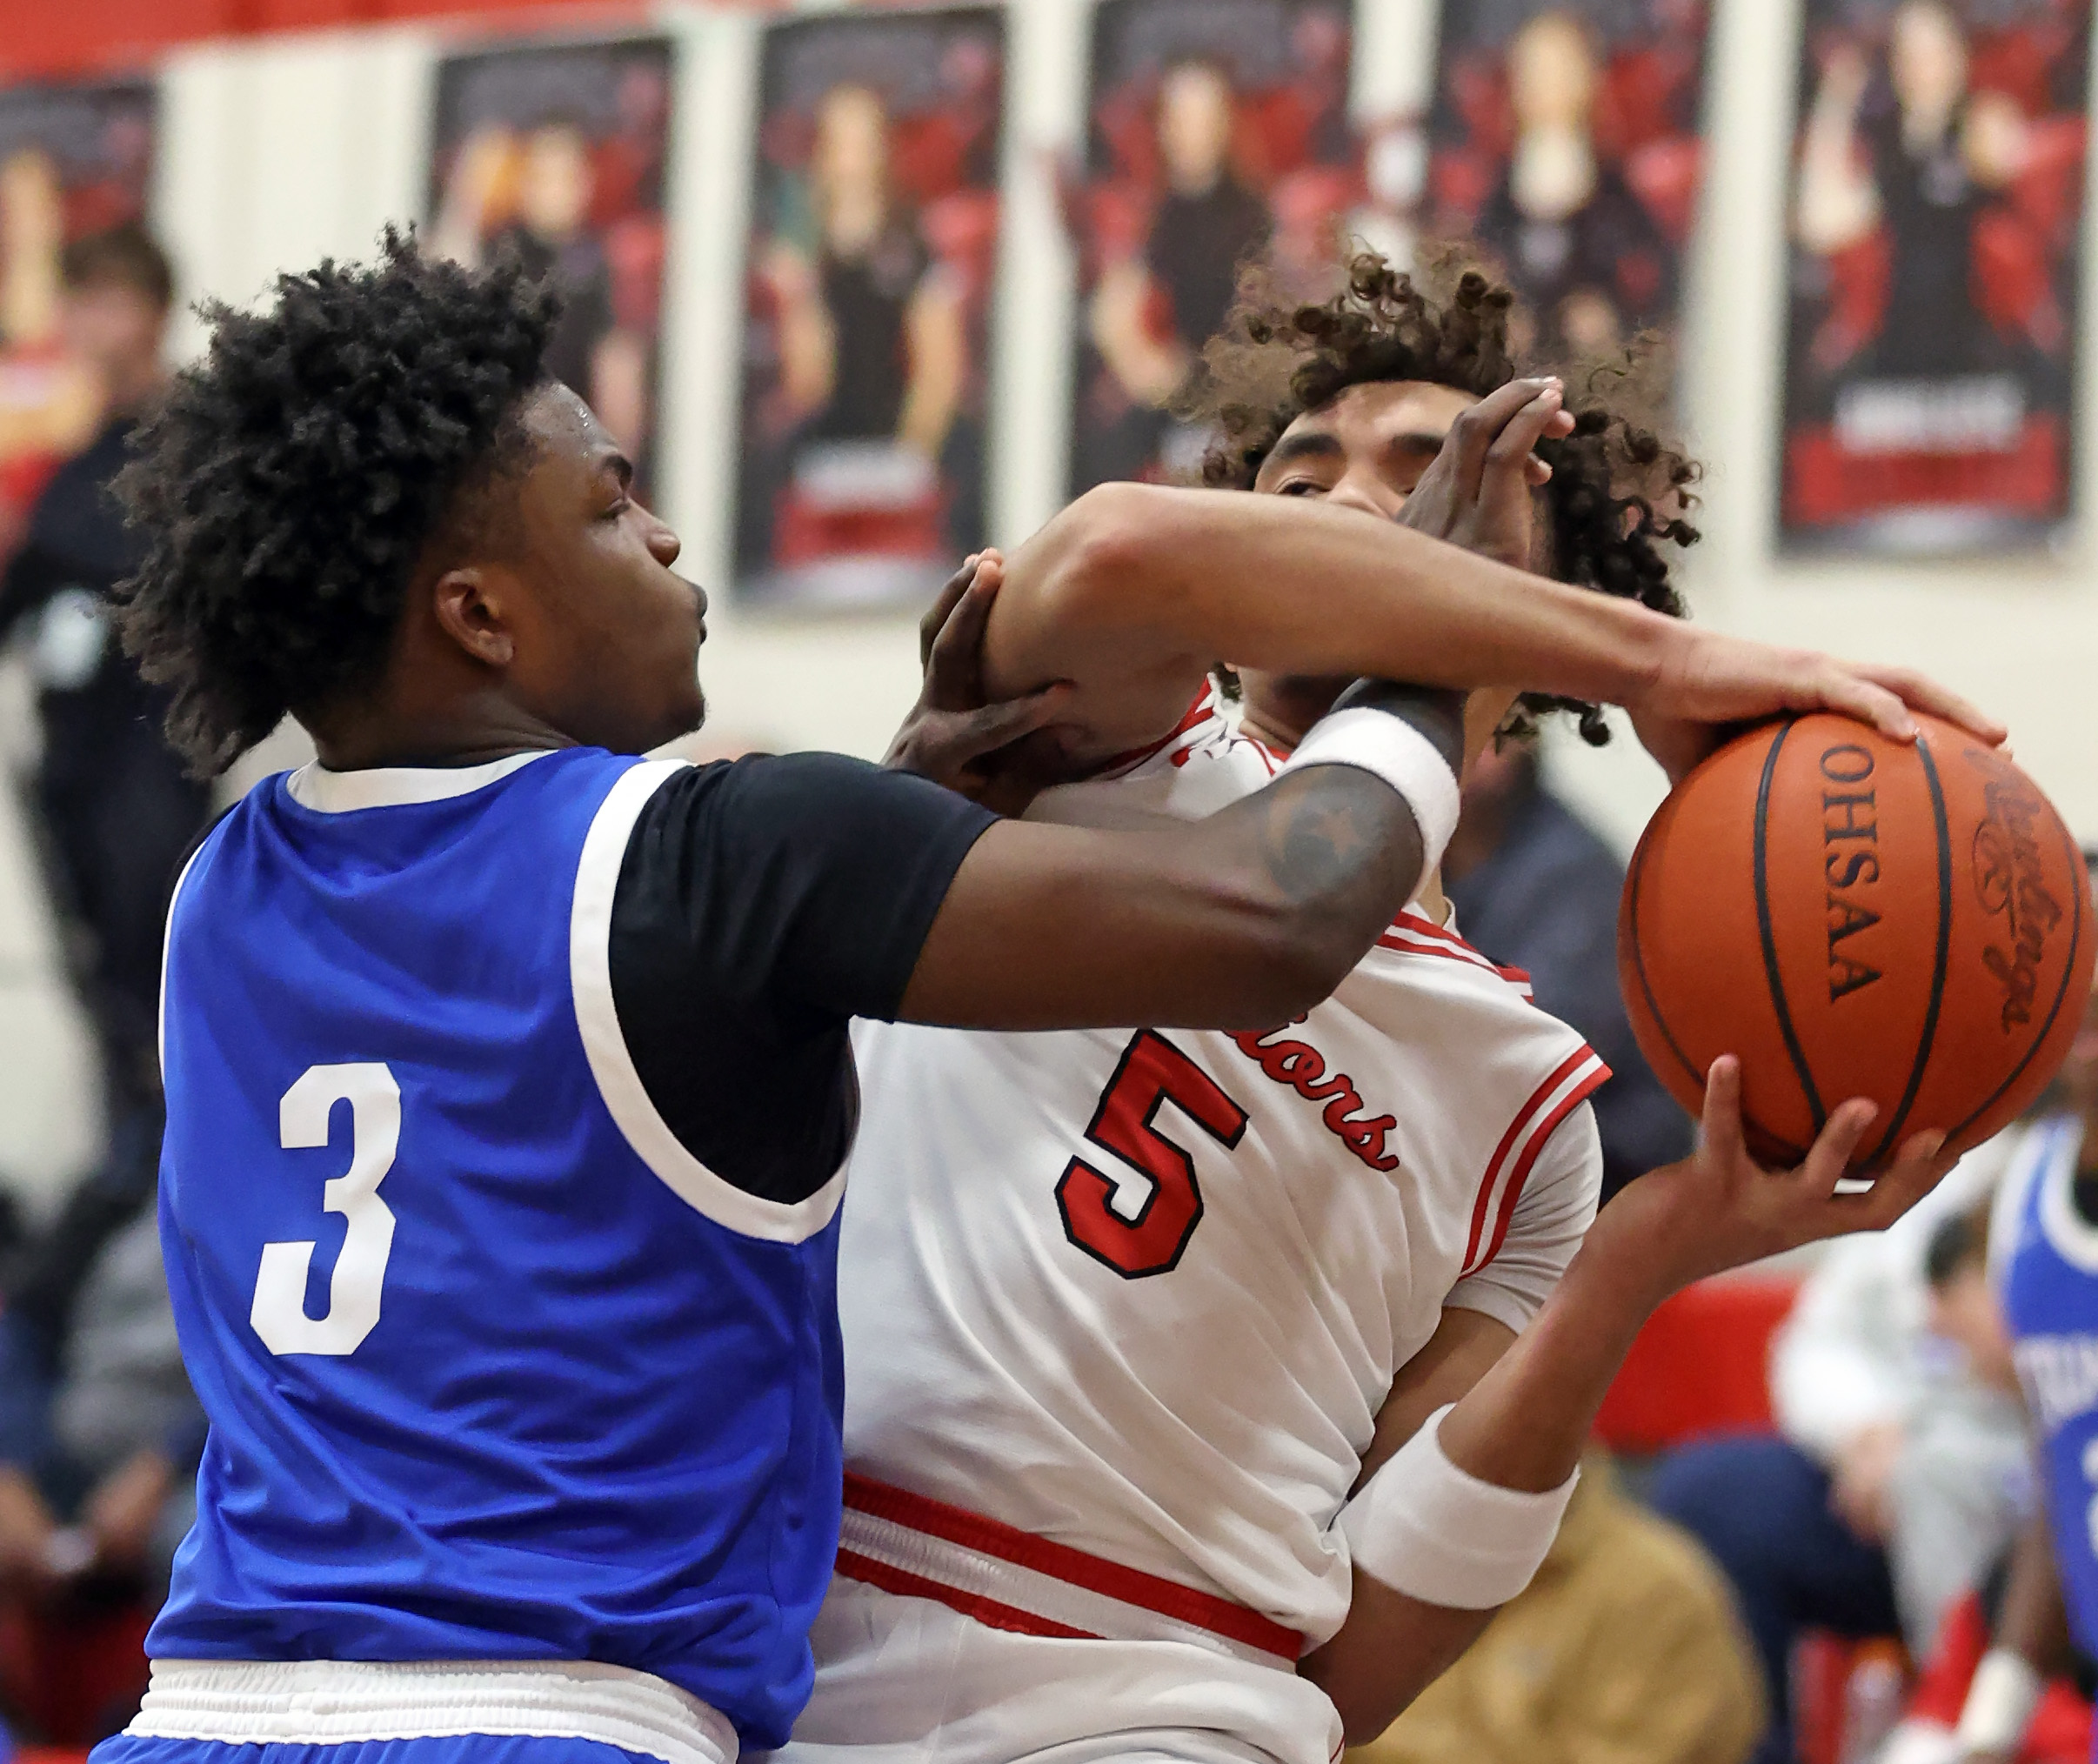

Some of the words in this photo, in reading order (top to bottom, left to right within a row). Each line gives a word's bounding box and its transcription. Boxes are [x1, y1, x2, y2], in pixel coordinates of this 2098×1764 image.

[1821, 744, 1881, 1004] OHSAA
[250, 1062, 401, 1356] 3
[1053, 1028, 1249, 1280] 5
